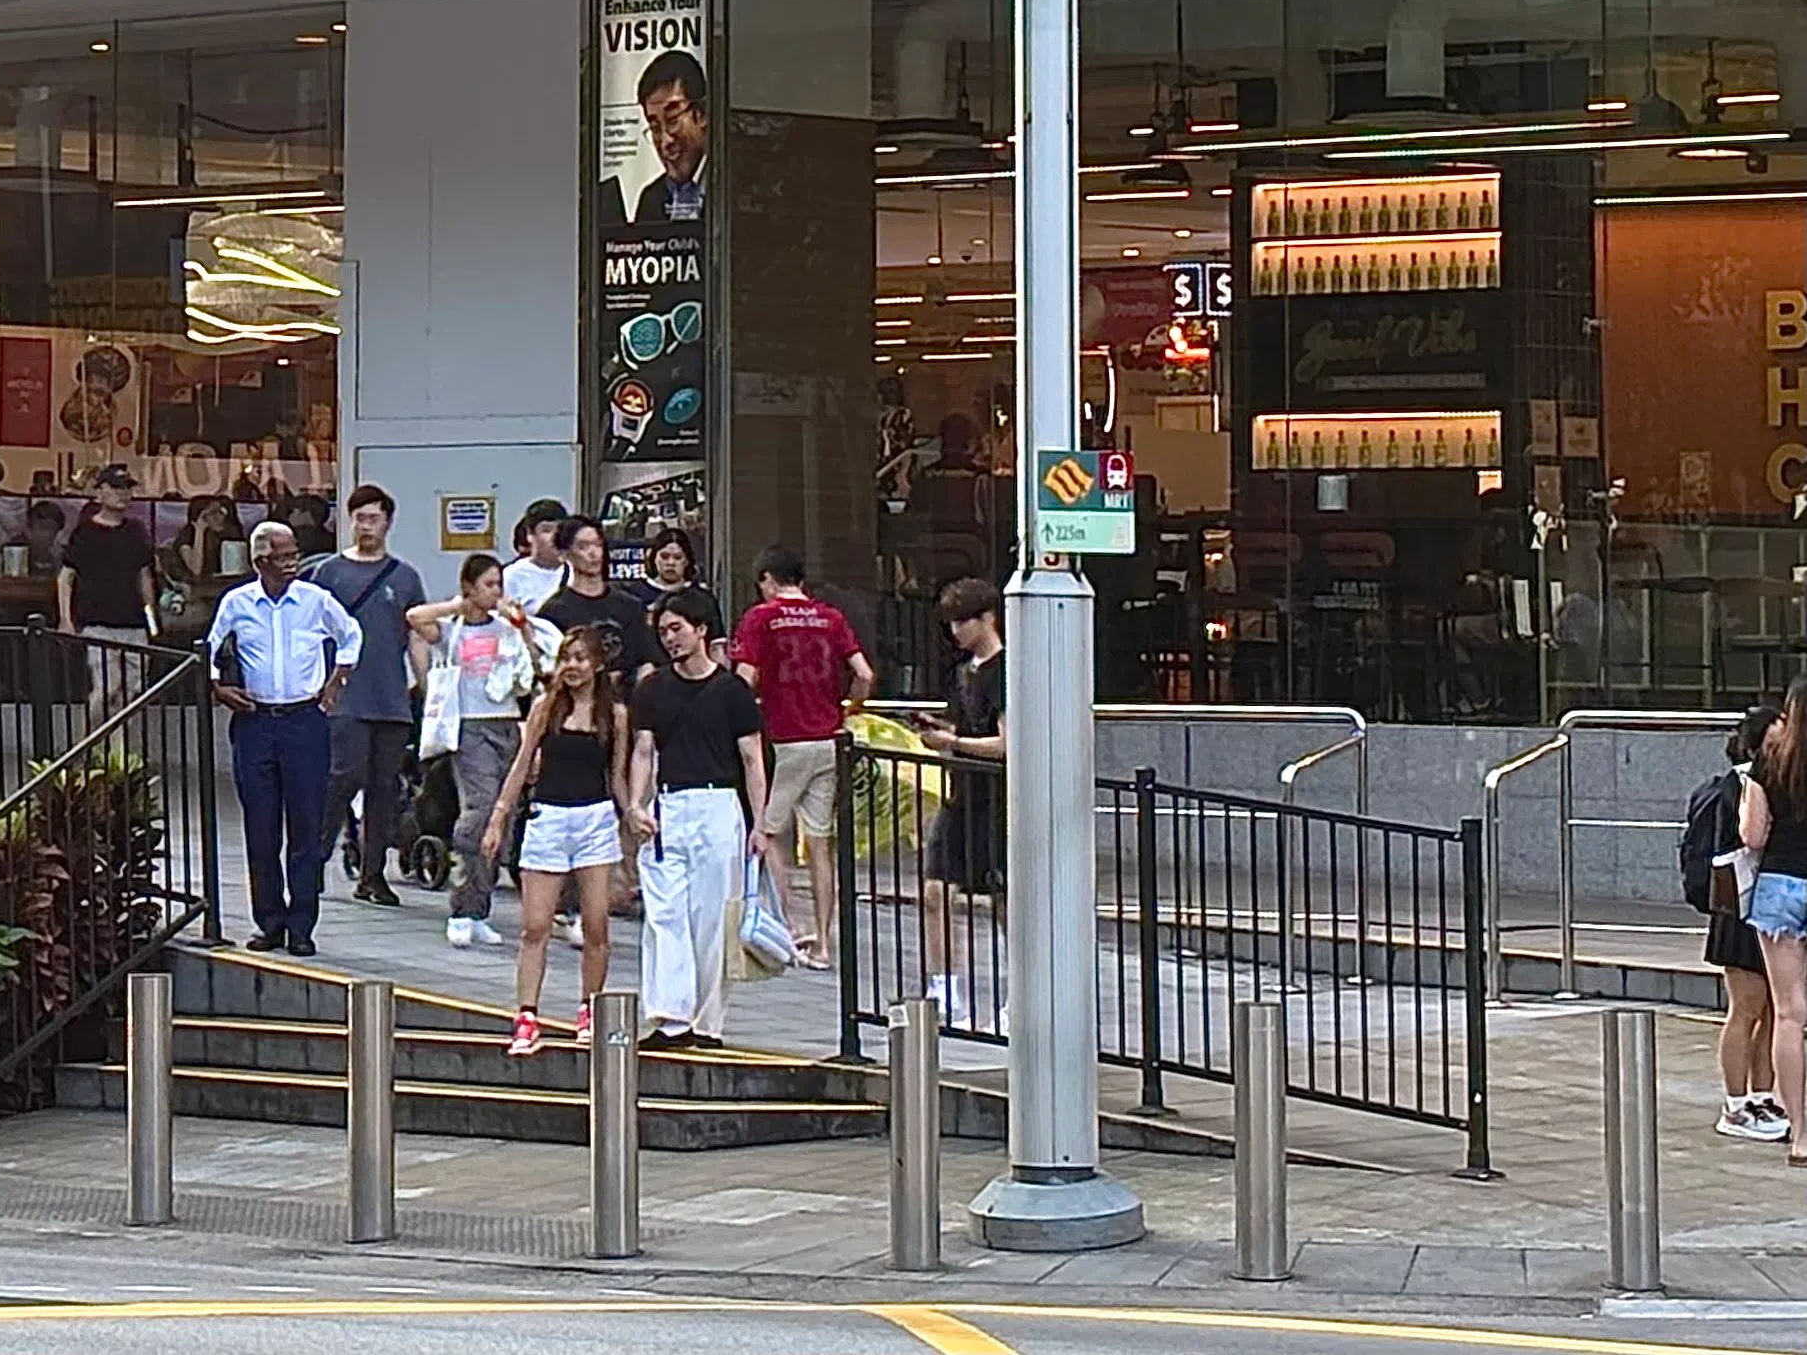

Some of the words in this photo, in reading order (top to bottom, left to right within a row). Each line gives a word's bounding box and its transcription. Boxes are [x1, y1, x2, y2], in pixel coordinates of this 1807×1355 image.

[604, 15, 702, 53] VISION
[605, 254, 701, 285] MYOPIA
[1103, 493, 1129, 509] MRT
